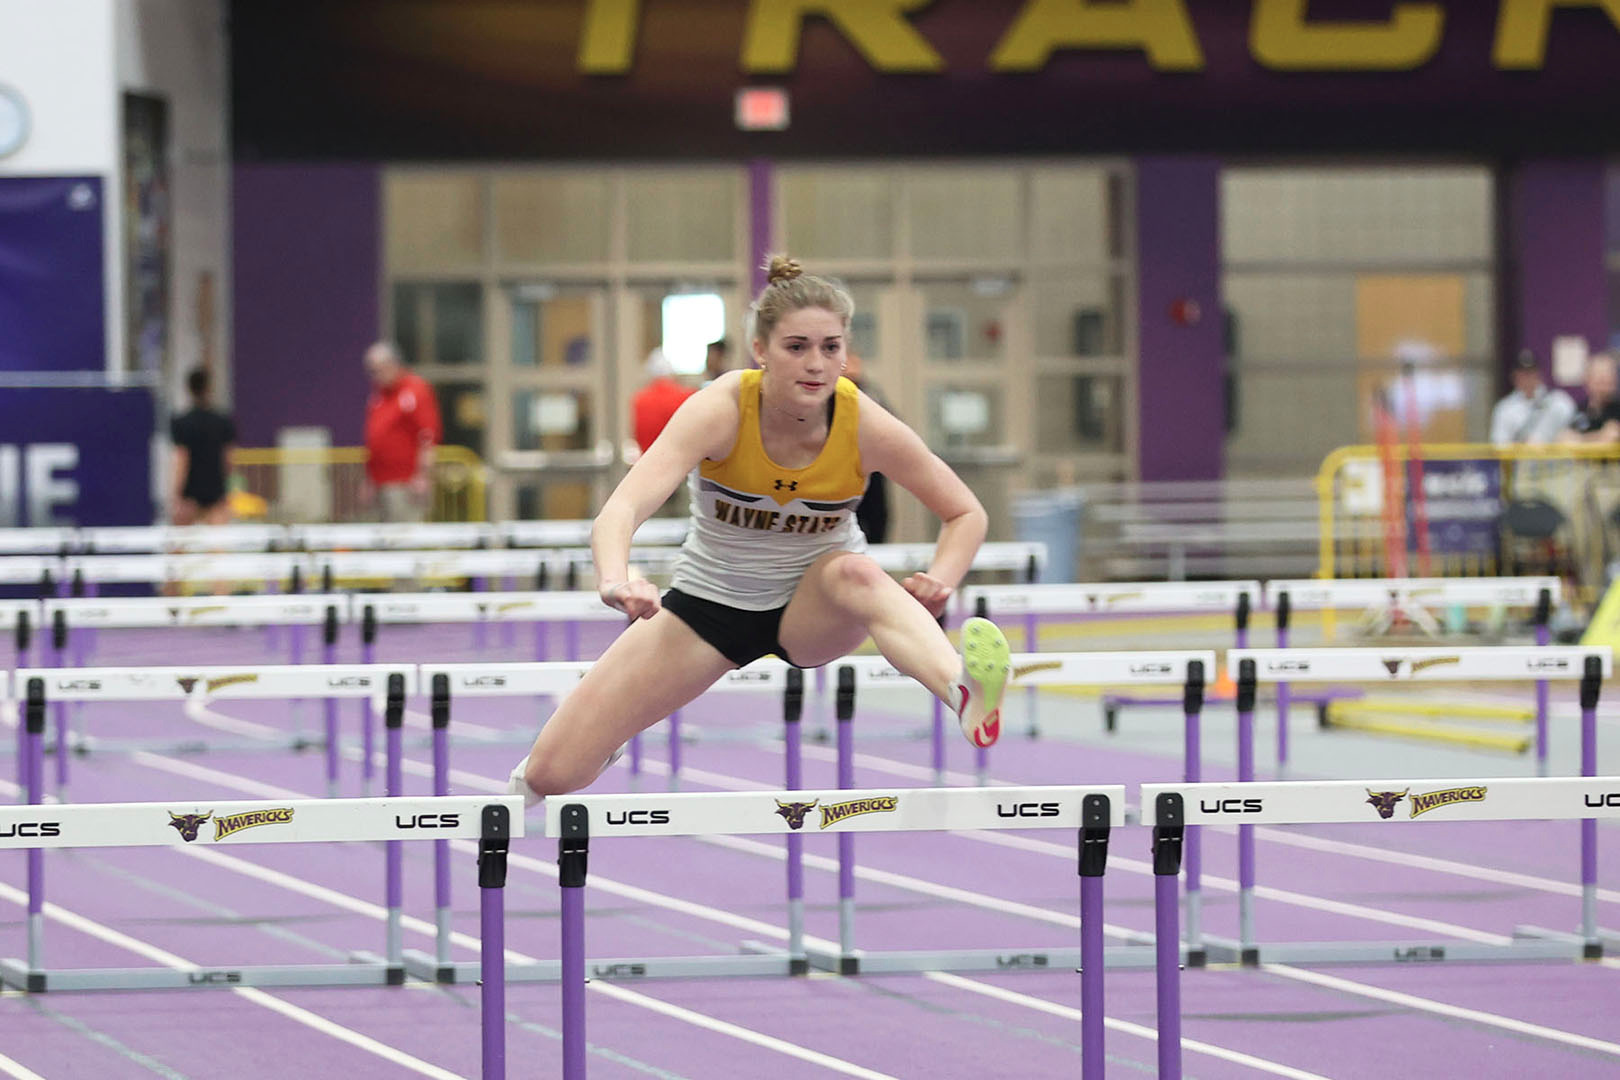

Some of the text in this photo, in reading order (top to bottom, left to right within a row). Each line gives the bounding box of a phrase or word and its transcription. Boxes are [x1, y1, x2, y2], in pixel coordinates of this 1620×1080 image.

[578, 0, 1620, 72] RAC
[715, 499, 780, 530] WAYNE
[607, 810, 670, 825] UCS
[820, 796, 898, 829] MAVERICKS
[998, 803, 1060, 817] UCS
[1201, 799, 1263, 813] UCS
[1410, 786, 1487, 819] MAVERICKS
[213, 808, 294, 841] MAVERICKS
[396, 814, 460, 828] UCS
